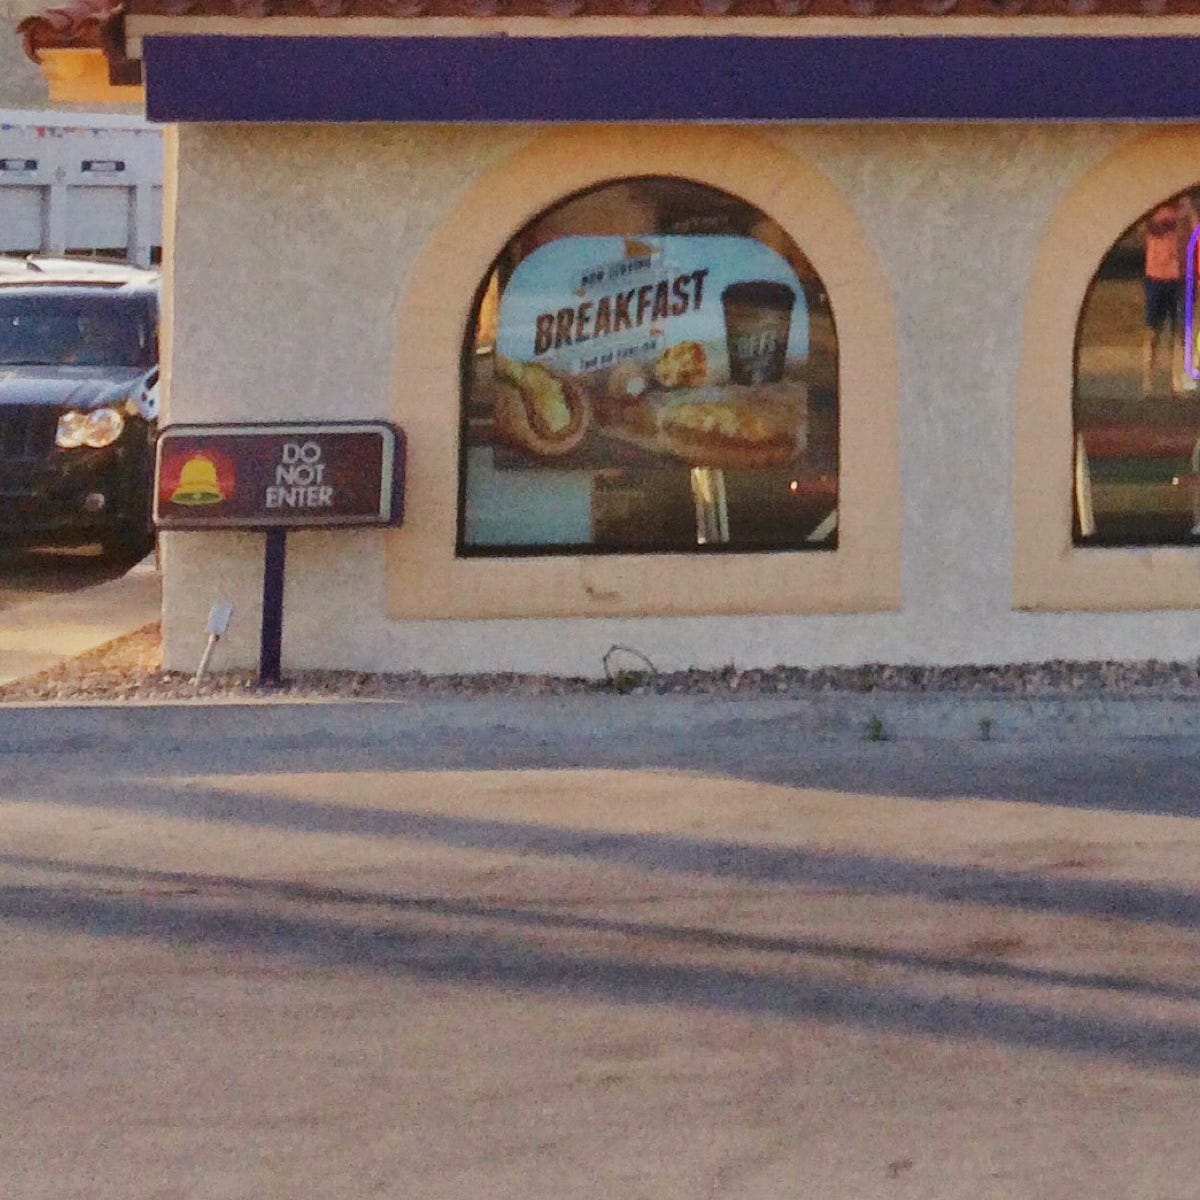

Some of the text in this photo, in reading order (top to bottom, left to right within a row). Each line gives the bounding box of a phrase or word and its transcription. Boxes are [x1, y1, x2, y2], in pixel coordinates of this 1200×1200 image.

[534, 267, 709, 356] BREAKFAST
[281, 441, 322, 465] DO
[275, 463, 325, 486] NOT
[265, 485, 334, 509] ENTER
